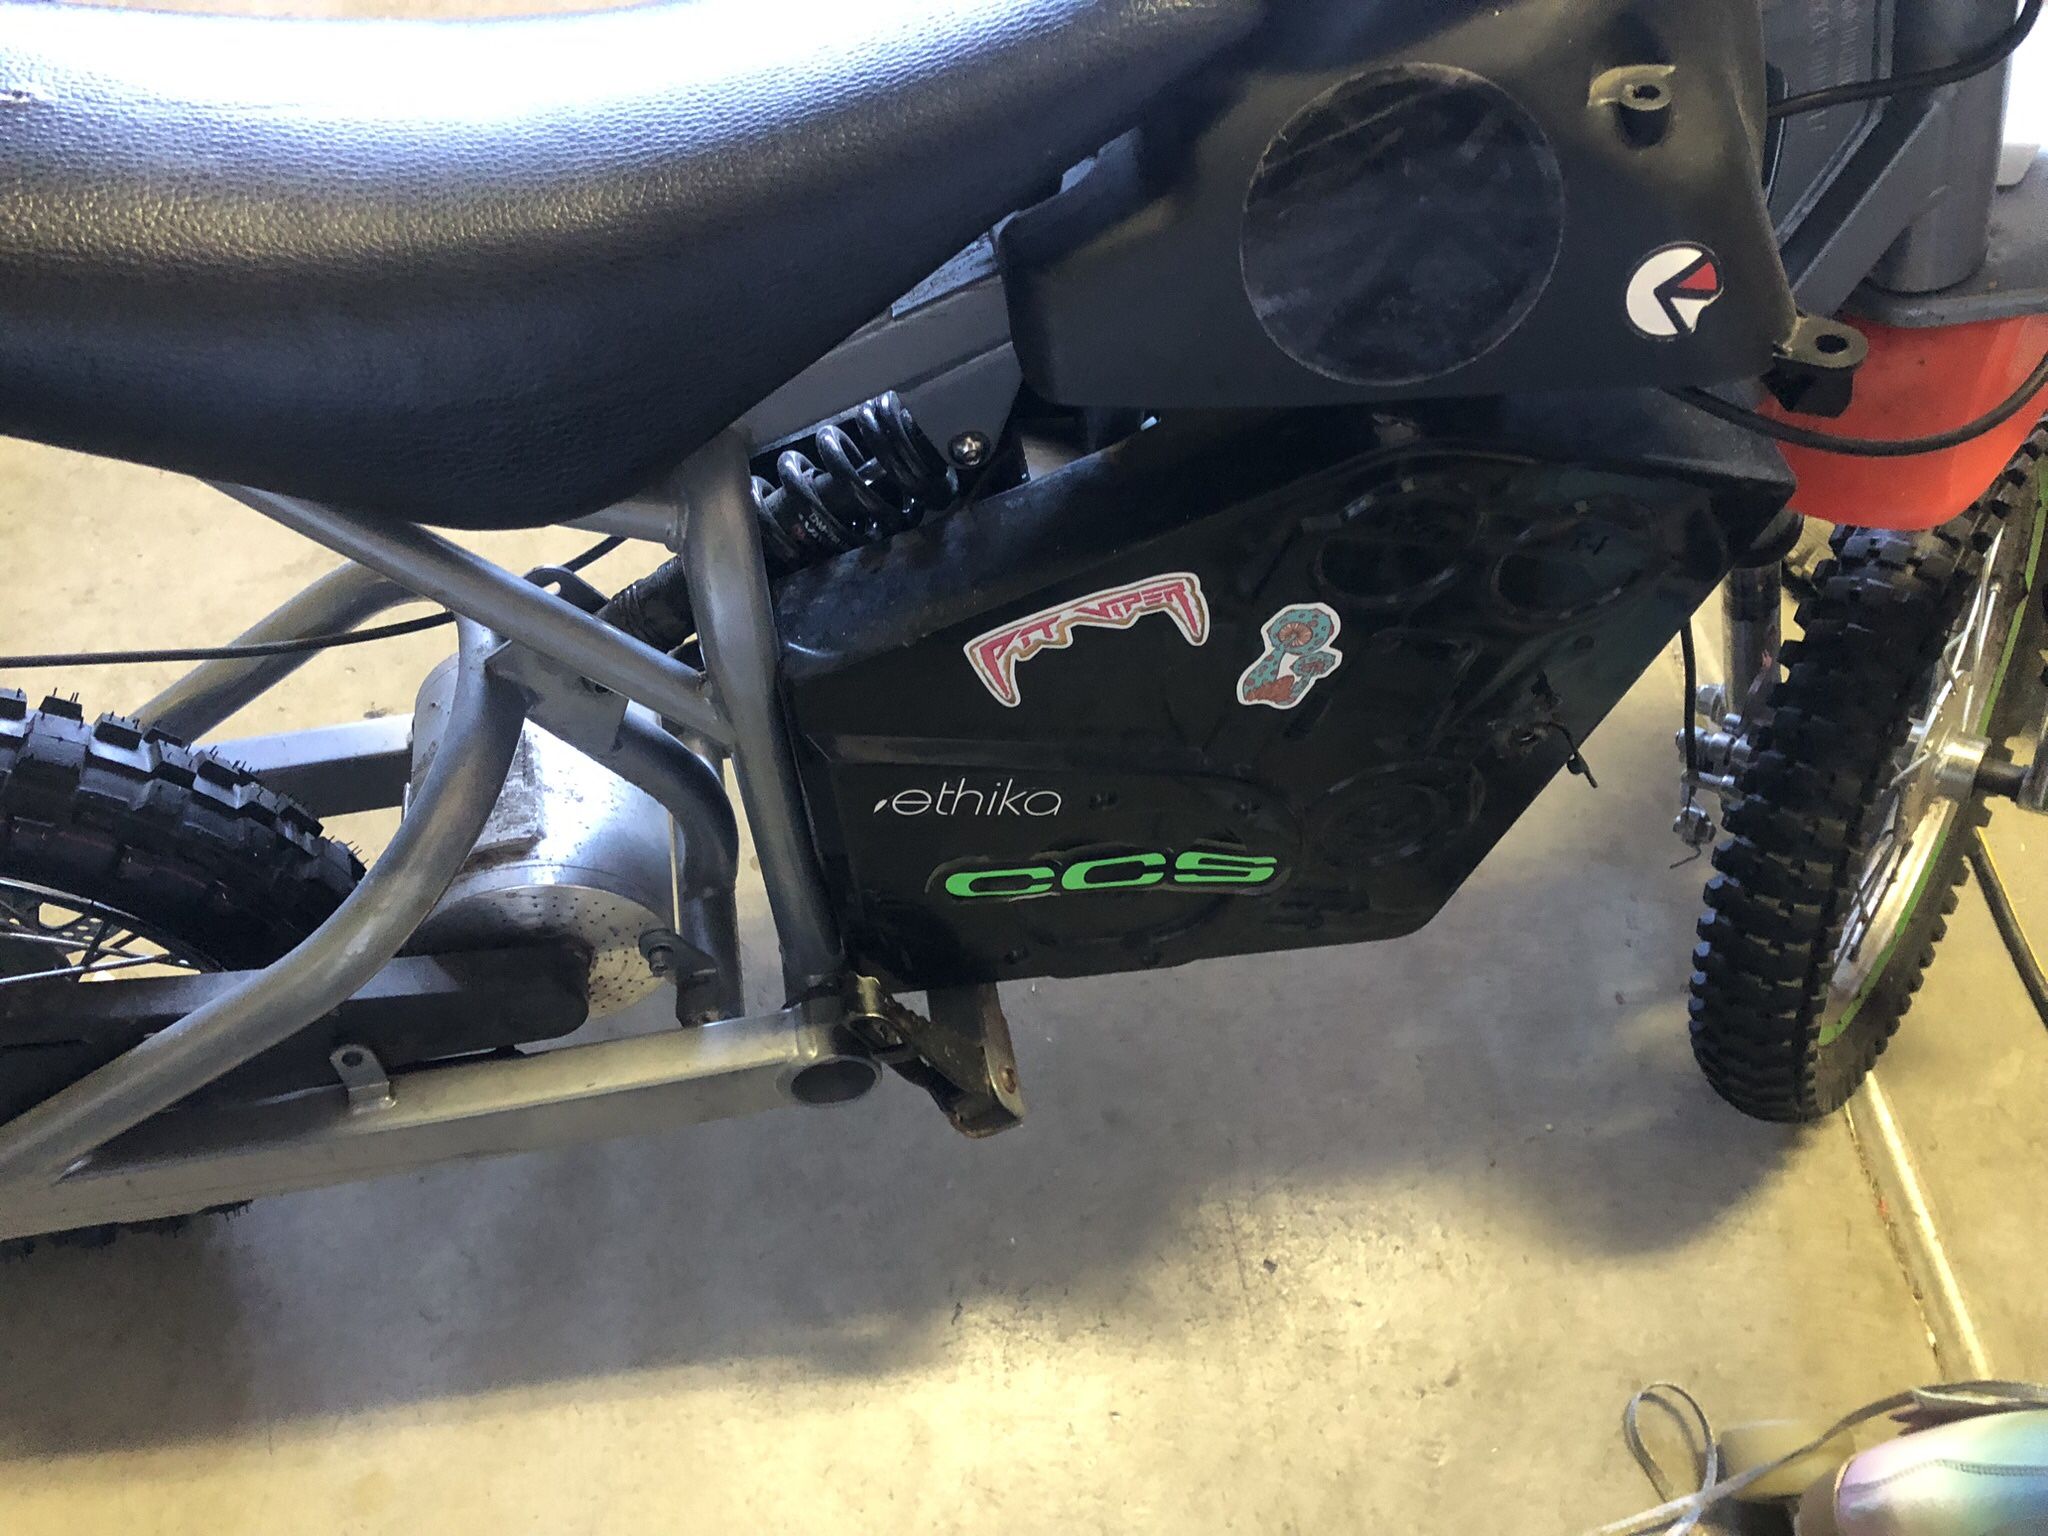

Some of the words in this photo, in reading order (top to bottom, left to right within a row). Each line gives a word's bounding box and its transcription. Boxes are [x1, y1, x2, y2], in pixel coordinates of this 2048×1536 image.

[1074, 581, 1199, 637] VIPER
[890, 778, 1062, 816] ethika
[945, 851, 1277, 897] CCS
